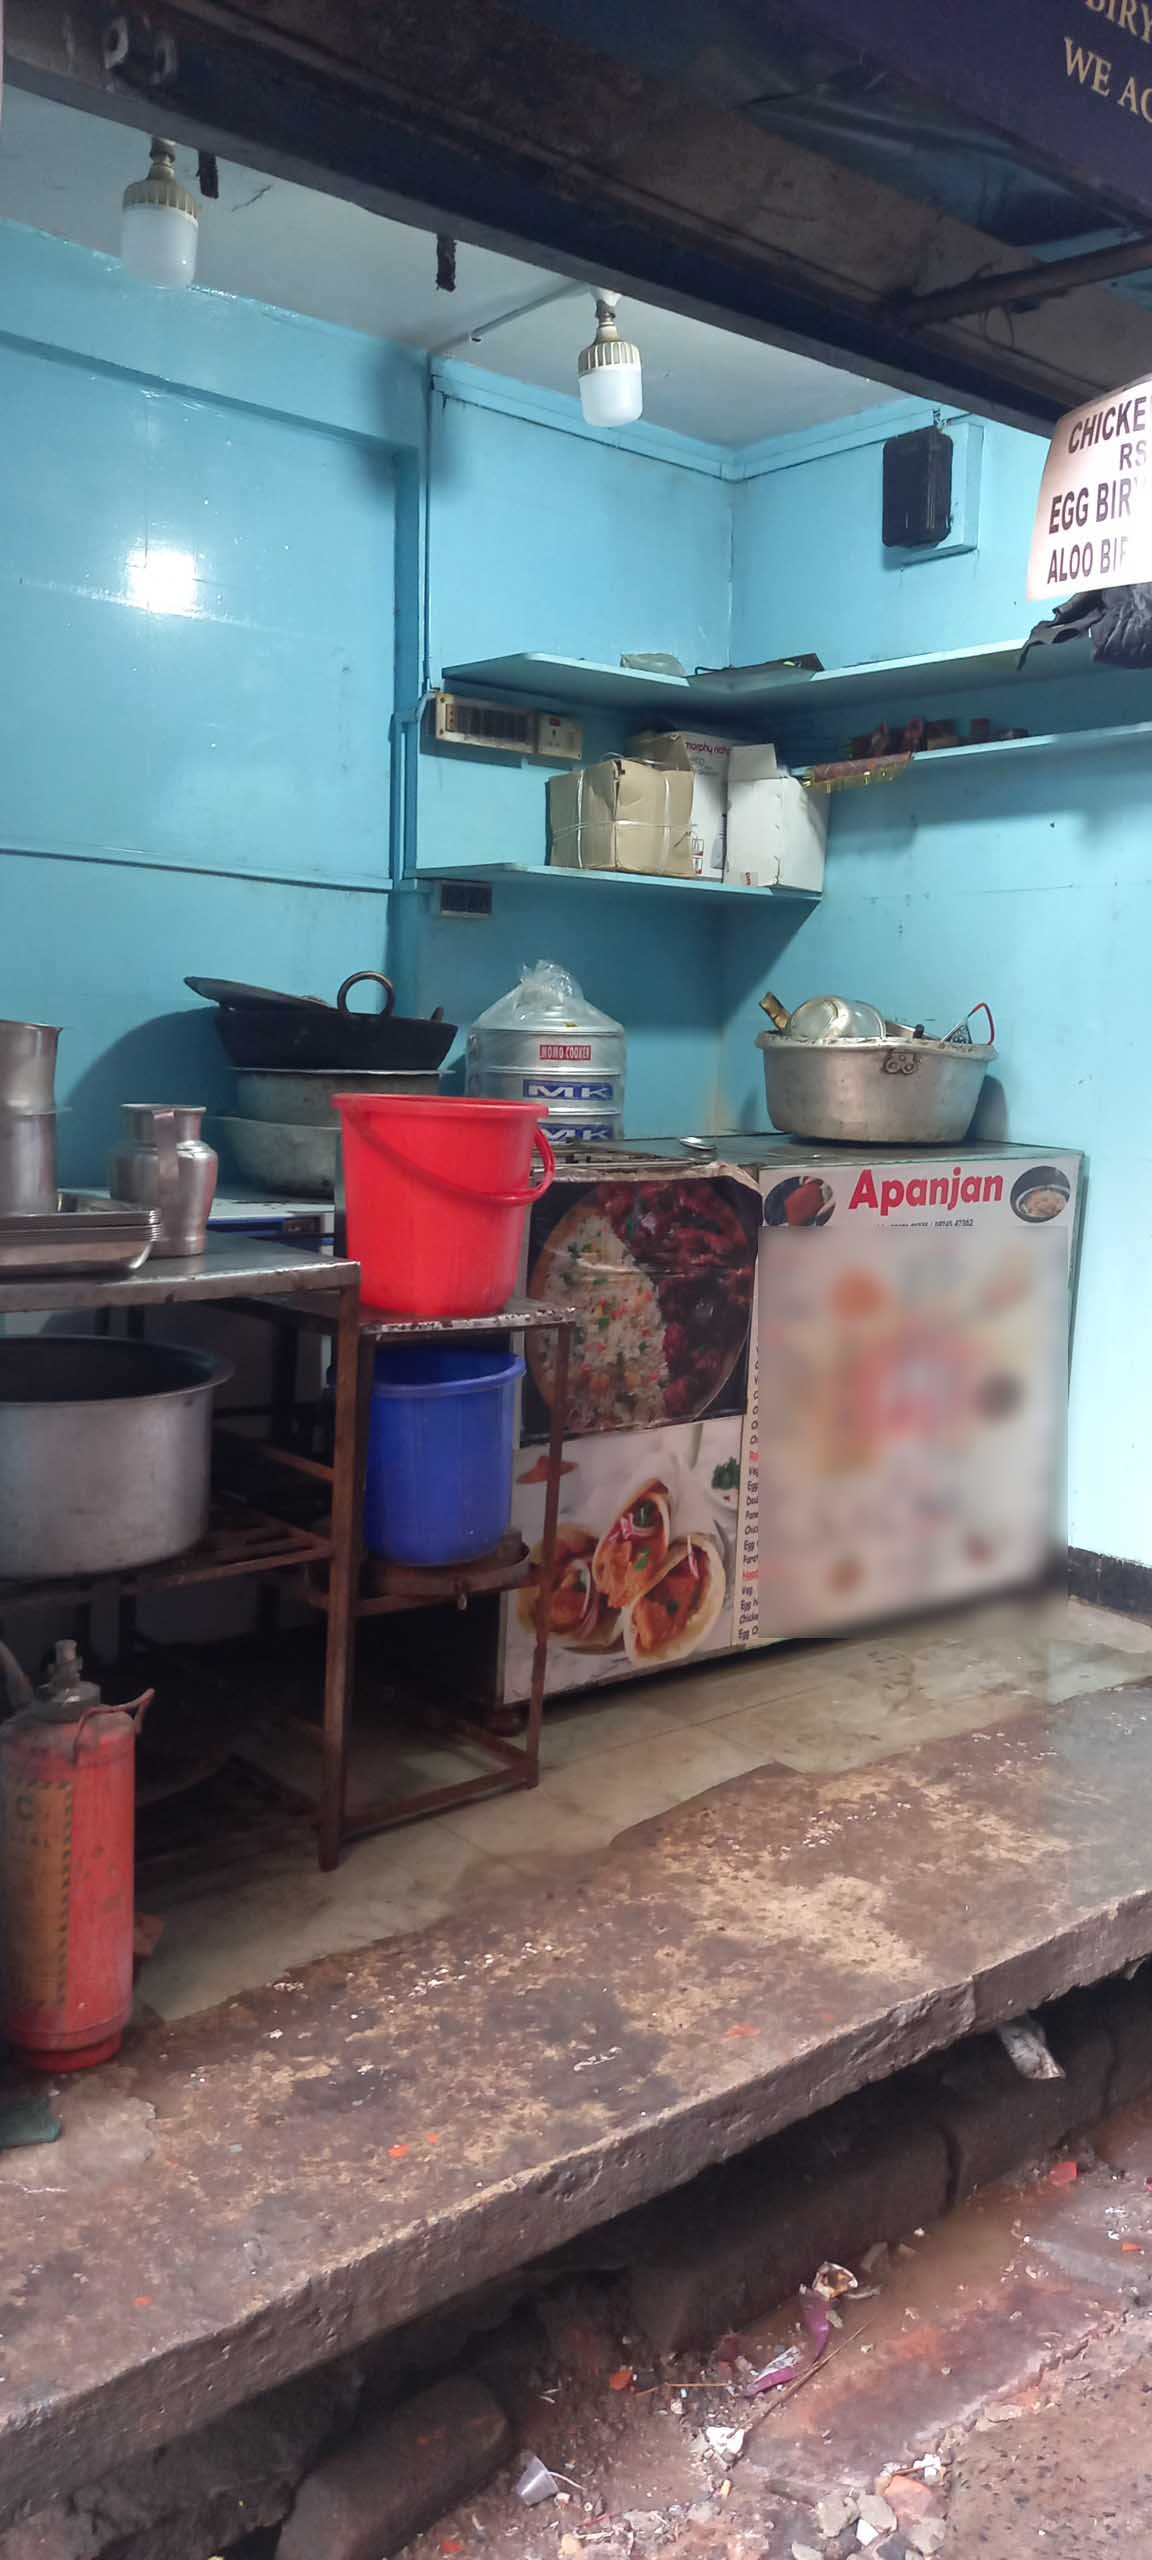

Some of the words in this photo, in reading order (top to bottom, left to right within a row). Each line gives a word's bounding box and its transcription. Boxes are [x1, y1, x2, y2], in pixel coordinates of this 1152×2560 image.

[1064, 36, 1112, 97] WE
[1068, 396, 1152, 454] CHICKE
[1049, 487, 1090, 535] EGG
[1096, 477, 1138, 523] BIR
[1047, 541, 1094, 585] ALOO
[565, 1046, 590, 1059] COOKER
[528, 1084, 609, 1099] MK
[848, 1167, 1003, 1216] Apanjan
